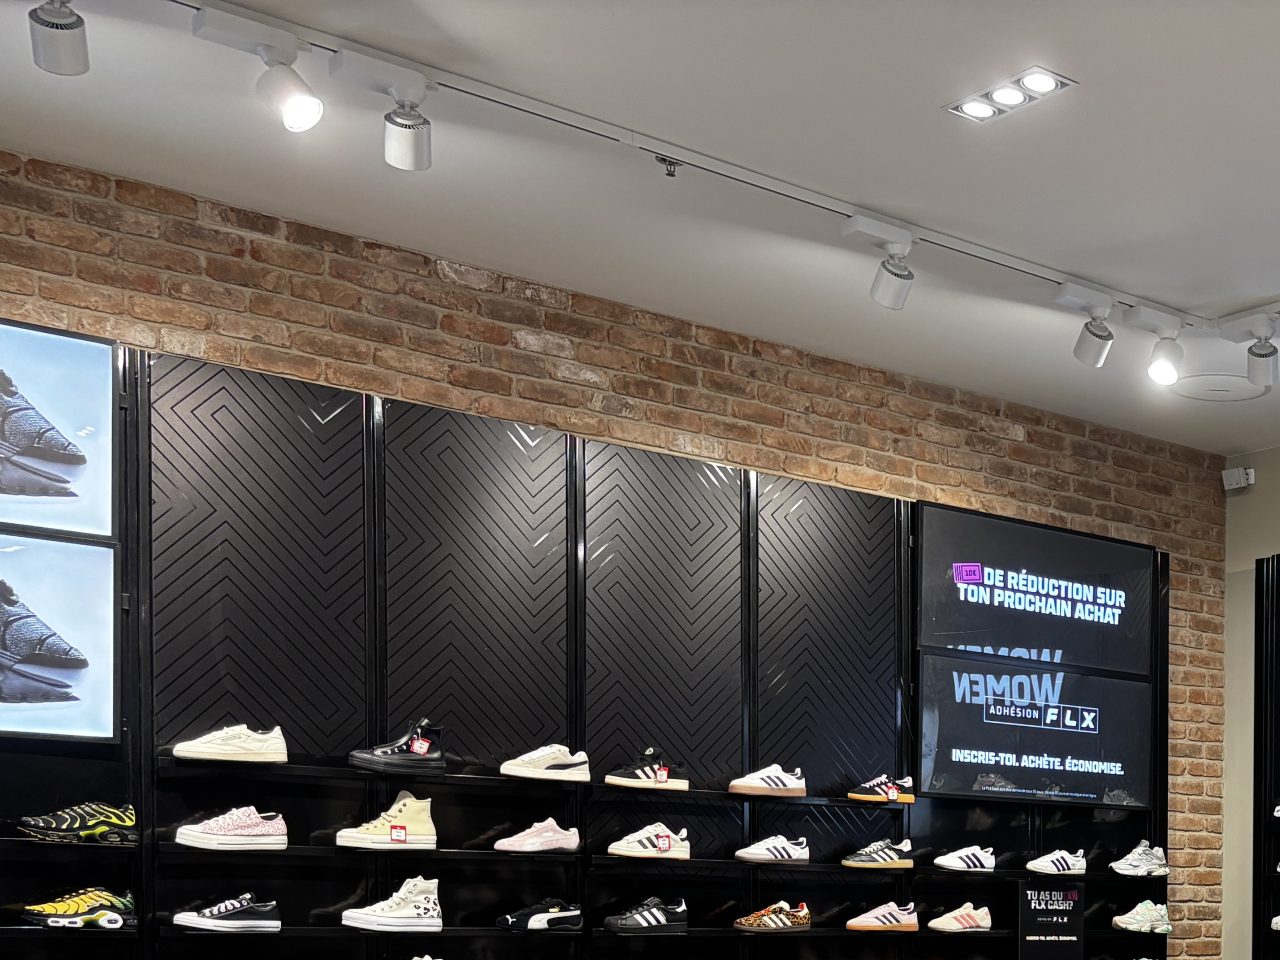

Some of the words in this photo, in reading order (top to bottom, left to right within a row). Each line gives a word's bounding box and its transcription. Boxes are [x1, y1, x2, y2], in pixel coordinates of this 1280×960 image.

[983, 567, 1004, 587] DE
[1007, 569, 1094, 602] RÉDUCTION
[1096, 586, 1126, 608] SUR
[957, 583, 991, 605] TON
[993, 589, 1072, 617] PROCHAIN
[1074, 602, 1122, 625] ACHAT
[989, 704, 1039, 719] ADHÉSION
[952, 748, 1019, 767] INSCRIS-TOI.
[1021, 754, 1064, 770] ACHÈTE.
[1065, 756, 1125, 775] ÉCONOMISE.
[1026, 890, 1038, 900] TU
[1039, 891, 1050, 900] AS
[1051, 891, 1063, 901] DU
[1031, 900, 1046, 910] FLX
[1047, 901, 1074, 910] CASH?
